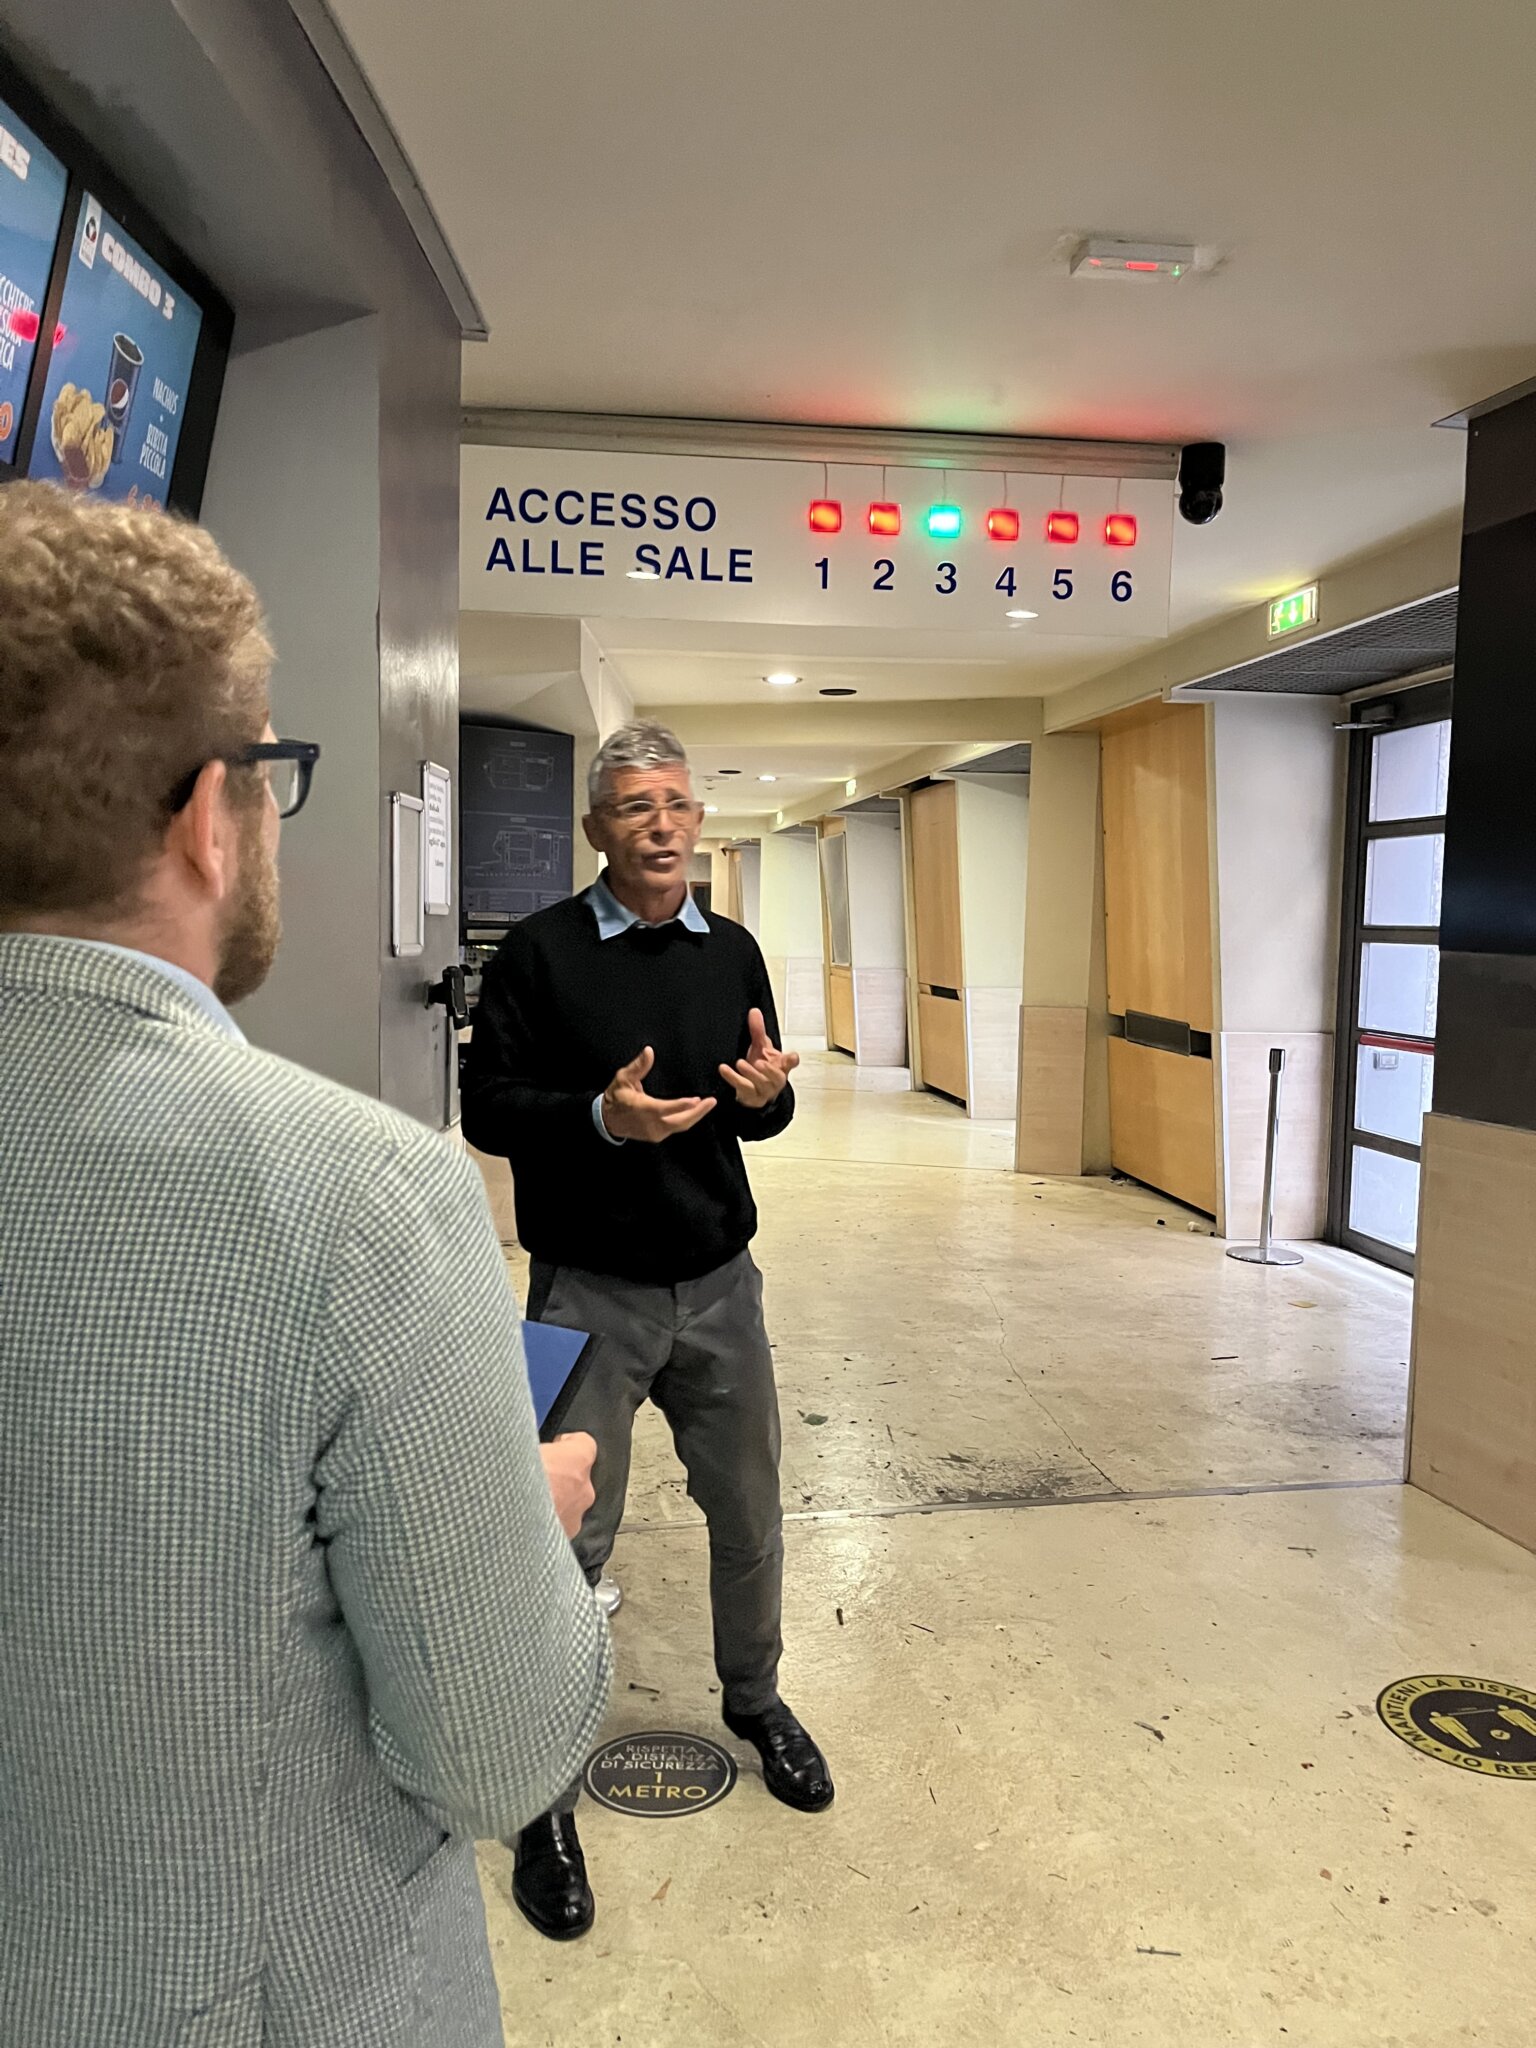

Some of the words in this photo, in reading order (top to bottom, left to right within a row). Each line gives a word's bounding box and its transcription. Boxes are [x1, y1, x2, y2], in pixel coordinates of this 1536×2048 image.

[102, 232, 161, 307] COMBO
[163, 292, 175, 320] 3
[152, 376, 179, 416] NACHOS
[139, 442, 167, 480] PICCOLA
[485, 487, 716, 532] ACCESSO
[485, 537, 605, 576] ALLE
[633, 543, 753, 583] SALE
[814, 557, 829, 590] 1
[873, 559, 895, 591] 2
[935, 562, 957, 594] 3
[995, 567, 1017, 597] 4
[1052, 568, 1073, 600] 5
[1111, 570, 1133, 602] 6
[1386, 1683, 1428, 1743] MANTIENI
[1420, 1679, 1452, 1689] LA
[601, 1760, 618, 1769] DI
[623, 1761, 720, 1771] SICUREZZA
[604, 1752, 625, 1760] LA
[631, 1753, 718, 1762] DISTANZA
[625, 1744, 698, 1754] RISPETTA
[1452, 1754, 1482, 1768] IO
[608, 1784, 707, 1799] METRO
[654, 1771, 662, 1784] 1
